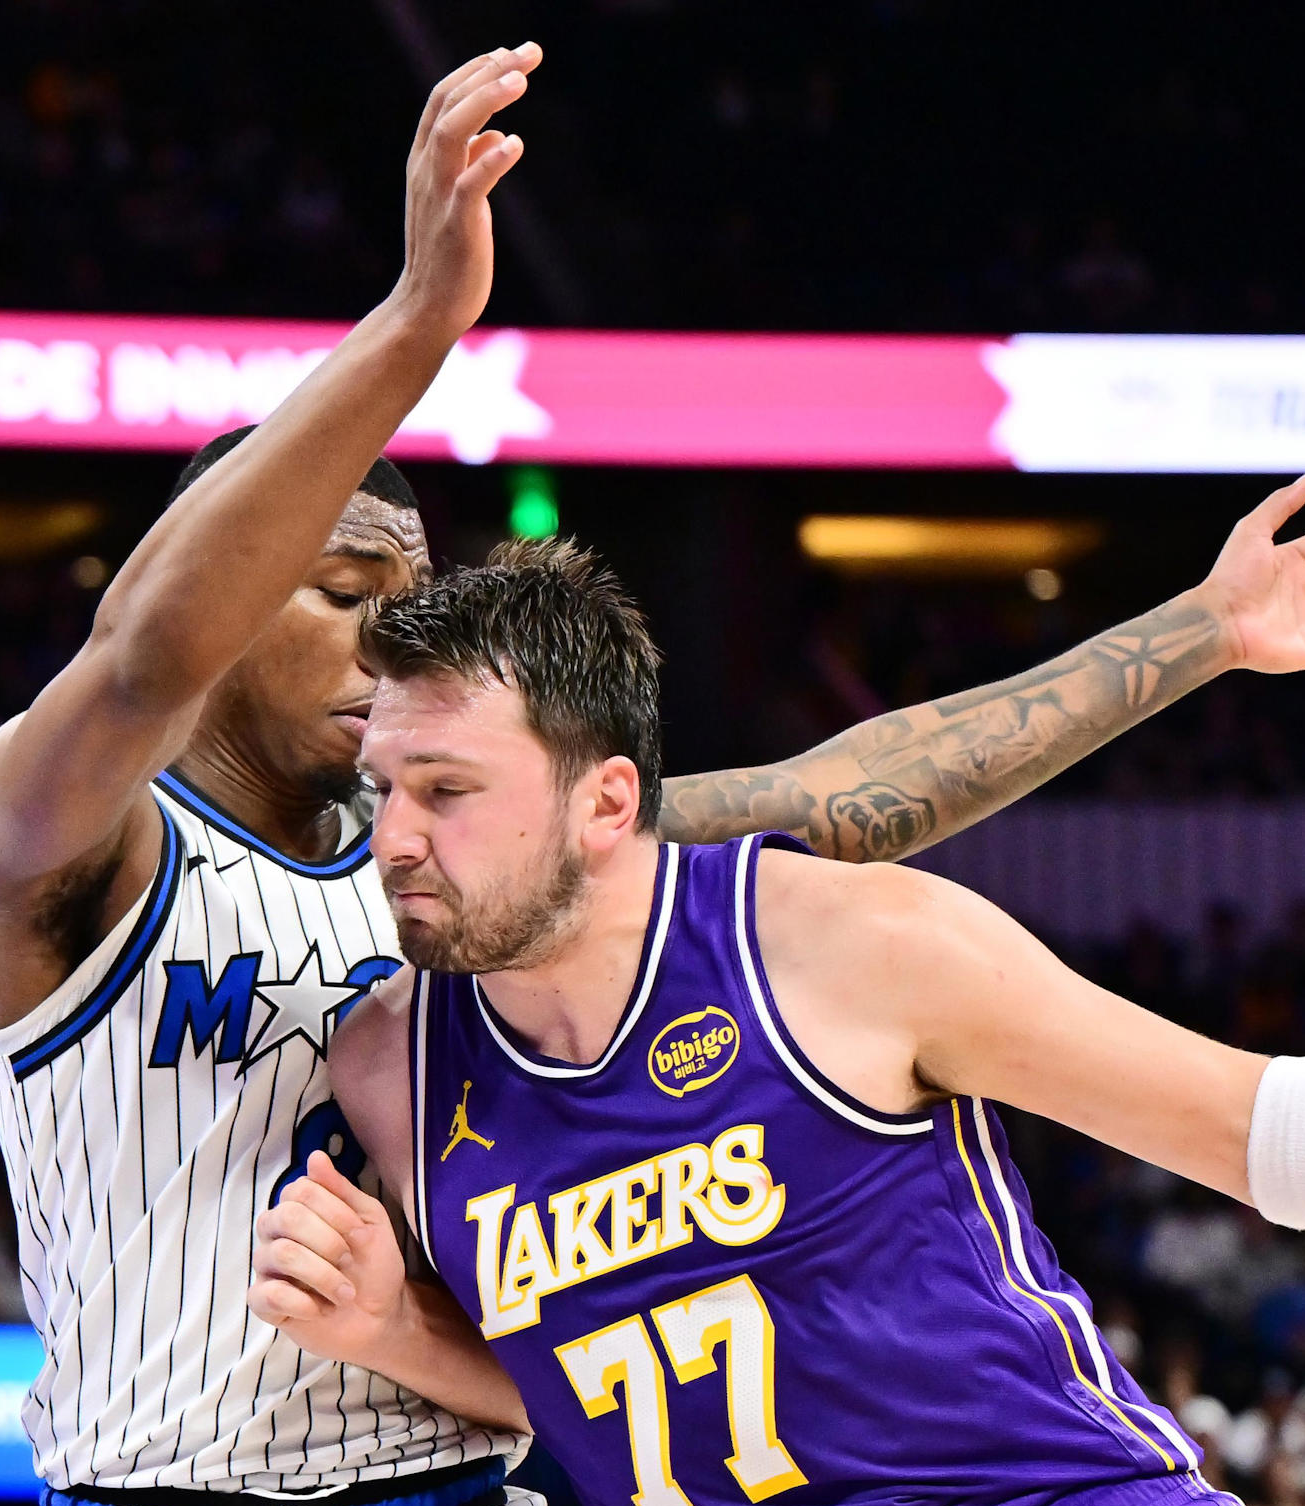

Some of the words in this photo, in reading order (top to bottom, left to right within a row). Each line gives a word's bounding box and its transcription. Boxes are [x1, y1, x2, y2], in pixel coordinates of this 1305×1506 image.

[655, 1026, 735, 1074] bibigo
[674, 1057, 707, 1080] 비비고
[466, 1124, 786, 1341] LAKERS
